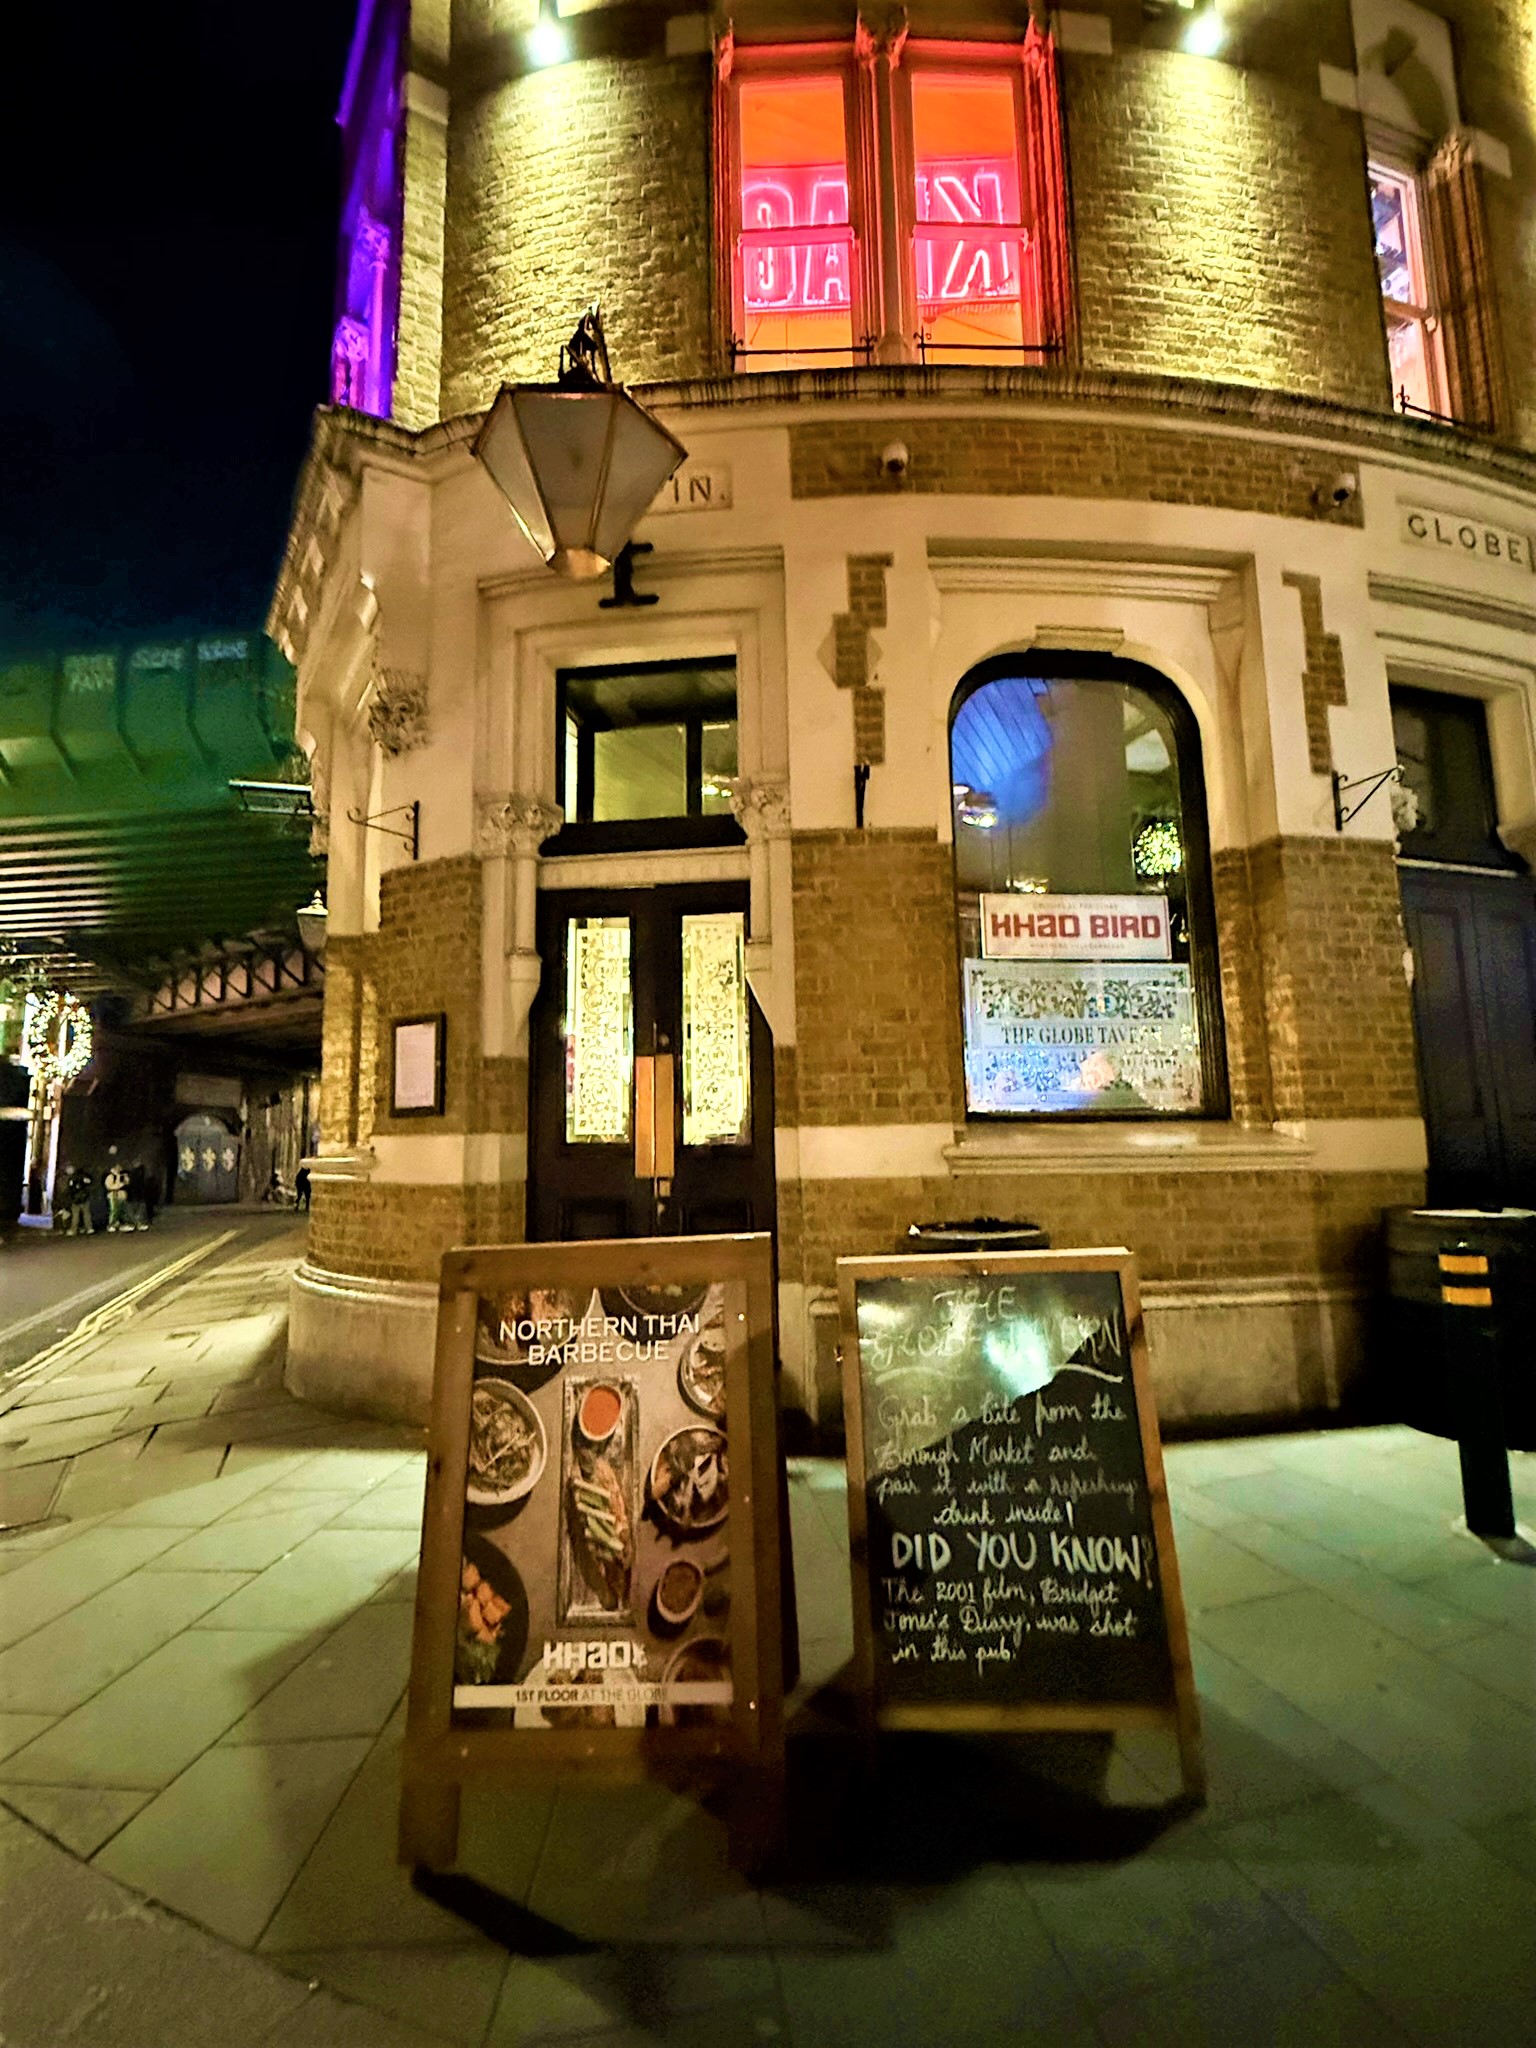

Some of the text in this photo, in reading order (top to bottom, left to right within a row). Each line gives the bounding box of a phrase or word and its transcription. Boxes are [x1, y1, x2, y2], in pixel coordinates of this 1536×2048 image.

[1090, 915, 1162, 938] BIRD
[1002, 1026, 1033, 1044] THE
[1039, 1026, 1093, 1044] GLOBE
[499, 1313, 699, 1342] NORTHERN THAI
[528, 1340, 669, 1366] BARBECUE
[877, 1391, 1127, 1437] Grab a bite from the
[968, 1433, 1035, 1466] Market
[1048, 1434, 1097, 1461] and
[876, 1471, 920, 1505] pair
[967, 1470, 1013, 1495] with
[1024, 1477, 1042, 1494] a
[933, 1500, 996, 1526] drink
[892, 1532, 951, 1573] DID
[967, 1531, 1037, 1572] YOU
[881, 1577, 925, 1604] The
[936, 1581, 976, 1602] 2001
[1040, 1577, 1120, 1619] Bridget
[1036, 1612, 1080, 1634] was
[1090, 1608, 1137, 1638] shot
[892, 1641, 920, 1664] in
[930, 1634, 968, 1663] this
[537, 1689, 578, 1701] FLOOR
[581, 1688, 596, 1700] AT
[599, 1688, 623, 1700] THE
